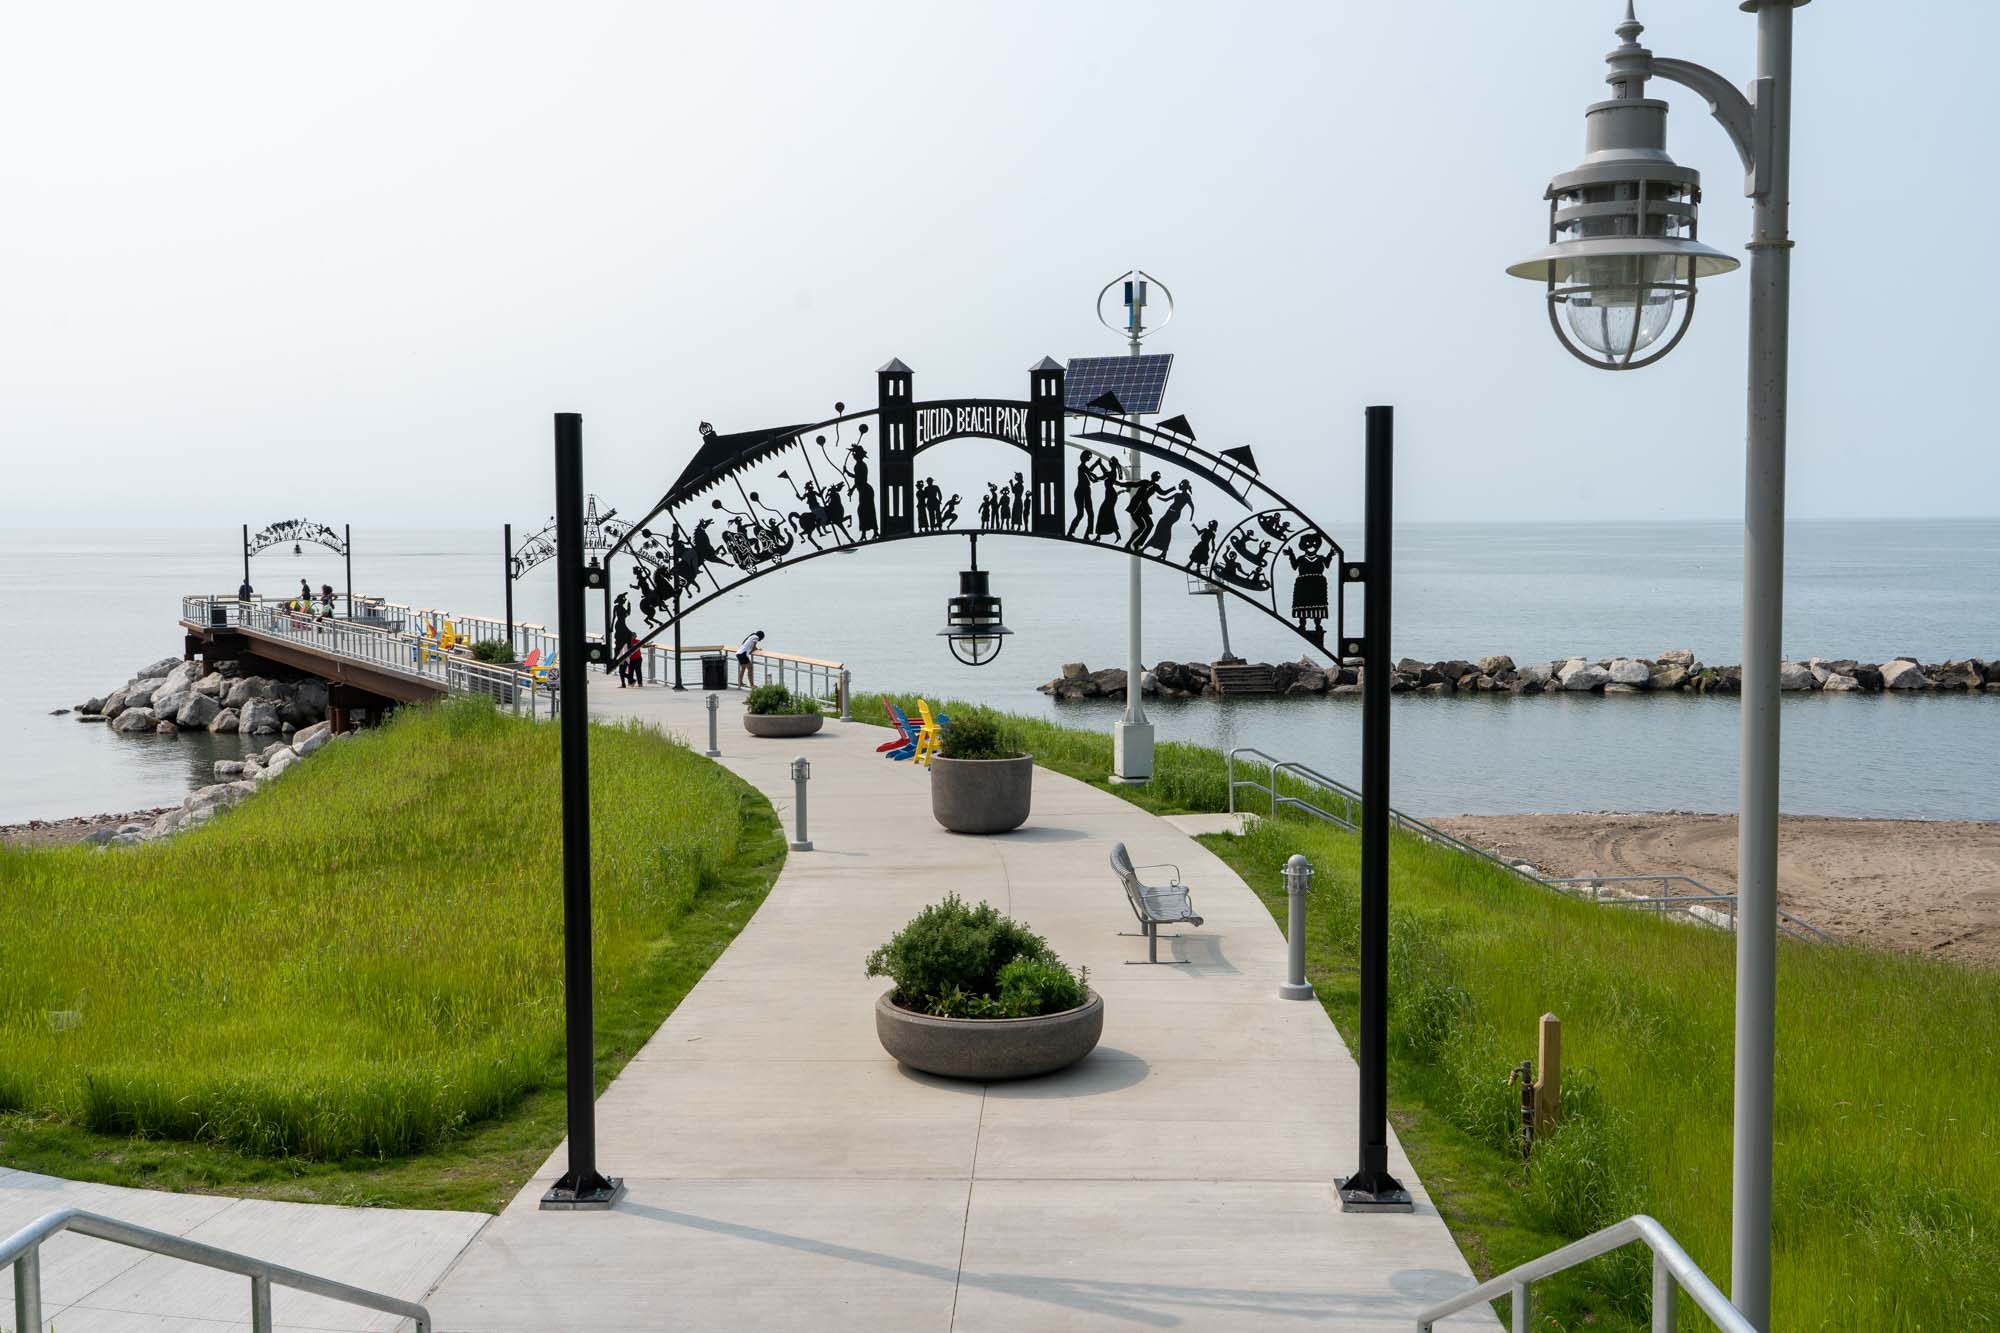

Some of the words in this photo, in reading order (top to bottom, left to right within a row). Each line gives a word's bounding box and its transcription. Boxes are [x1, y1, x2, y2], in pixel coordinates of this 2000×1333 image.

[916, 407, 953, 448] EUCLID
[956, 406, 993, 434] BEACH
[996, 406, 1029, 447] PARK
